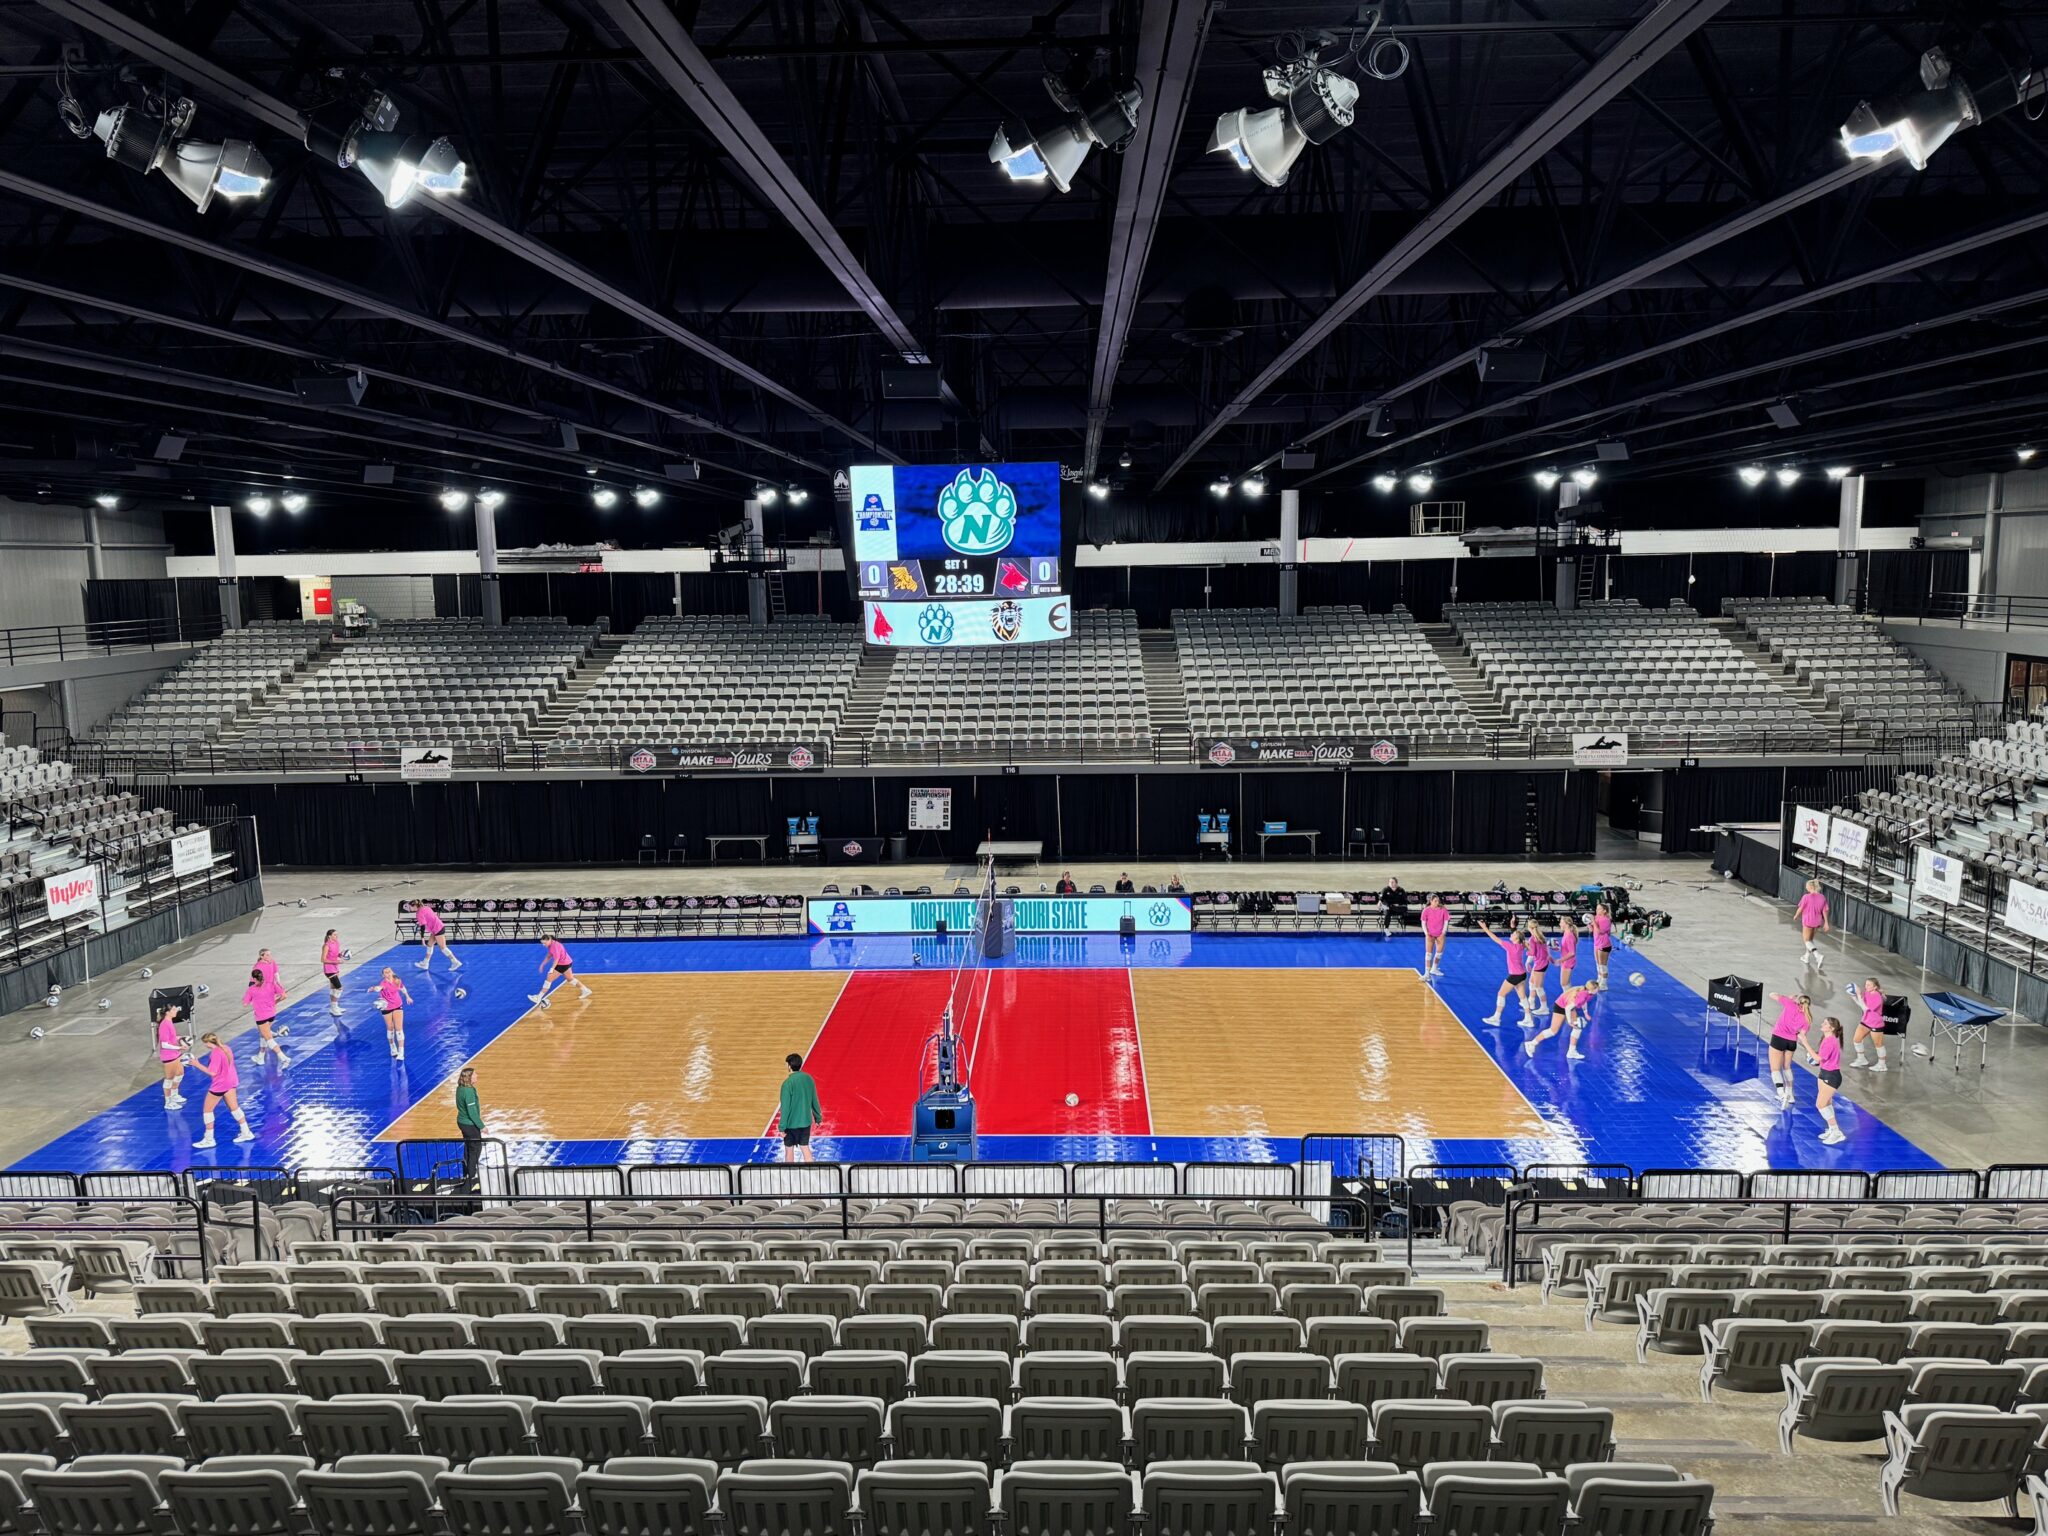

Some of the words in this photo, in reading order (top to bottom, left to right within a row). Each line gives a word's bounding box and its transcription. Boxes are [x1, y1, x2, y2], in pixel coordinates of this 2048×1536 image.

[958, 514, 992, 544] N
[945, 560, 960, 570] SET
[962, 560, 968, 570] 1
[868, 564, 880, 585] 0
[1038, 561, 1051, 582] 0
[935, 574, 984, 594] 28:39
[927, 625, 943, 640] N
[1259, 749, 1294, 759] MAKE
[679, 756, 714, 766] MAKE
[1684, 759, 1696, 767] 118
[349, 774, 360, 782] 114
[911, 901, 976, 930] NORTHWES
[1014, 901, 1050, 930] SOURI
[1051, 901, 1088, 929] STATE
[1154, 914, 1164, 924] N
[1882, 1015, 1899, 1024] lten
